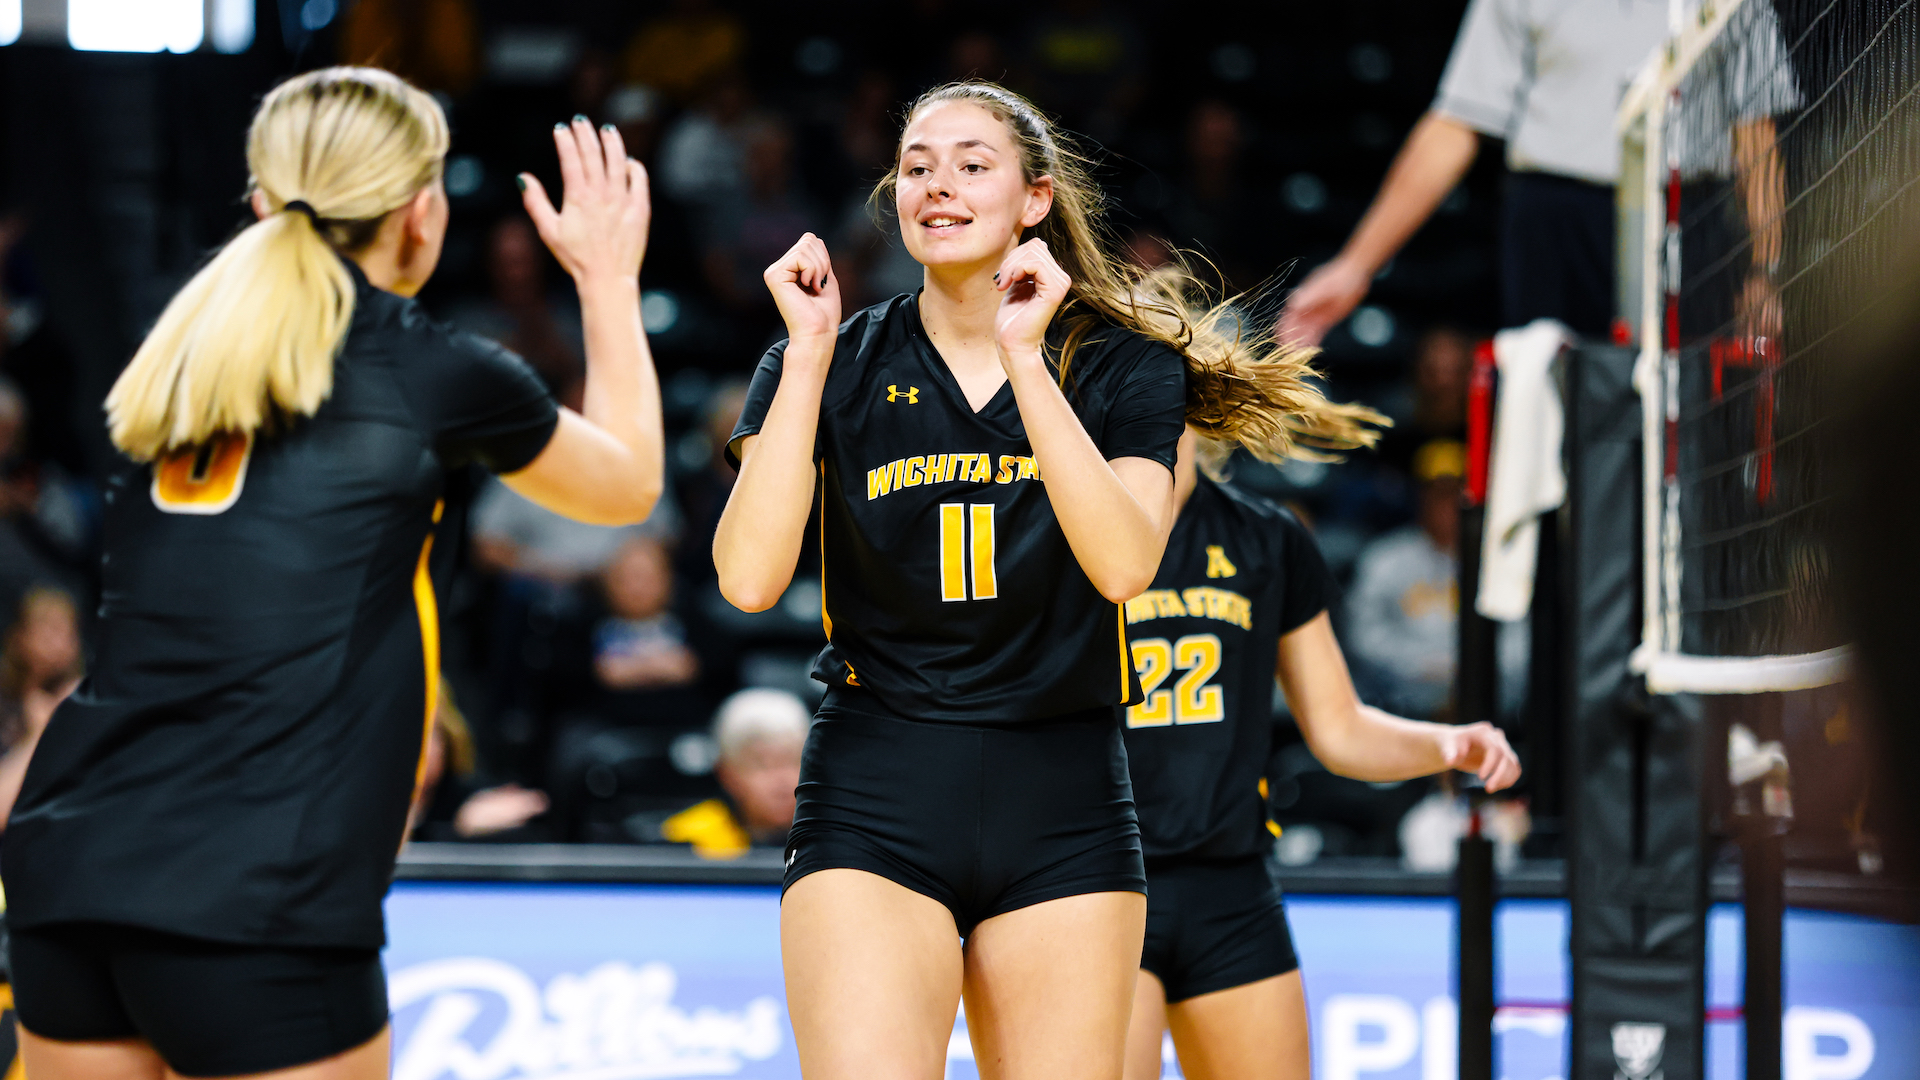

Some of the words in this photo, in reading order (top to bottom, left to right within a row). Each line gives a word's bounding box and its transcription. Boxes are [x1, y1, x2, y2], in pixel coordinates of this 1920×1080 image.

[867, 452, 992, 501] WICHITA
[995, 454, 1044, 484] STA
[939, 502, 998, 602] 11
[1206, 544, 1237, 579] A
[1125, 589, 1187, 625] HITA
[1182, 585, 1252, 631] STATE
[1126, 633, 1225, 729] 22
